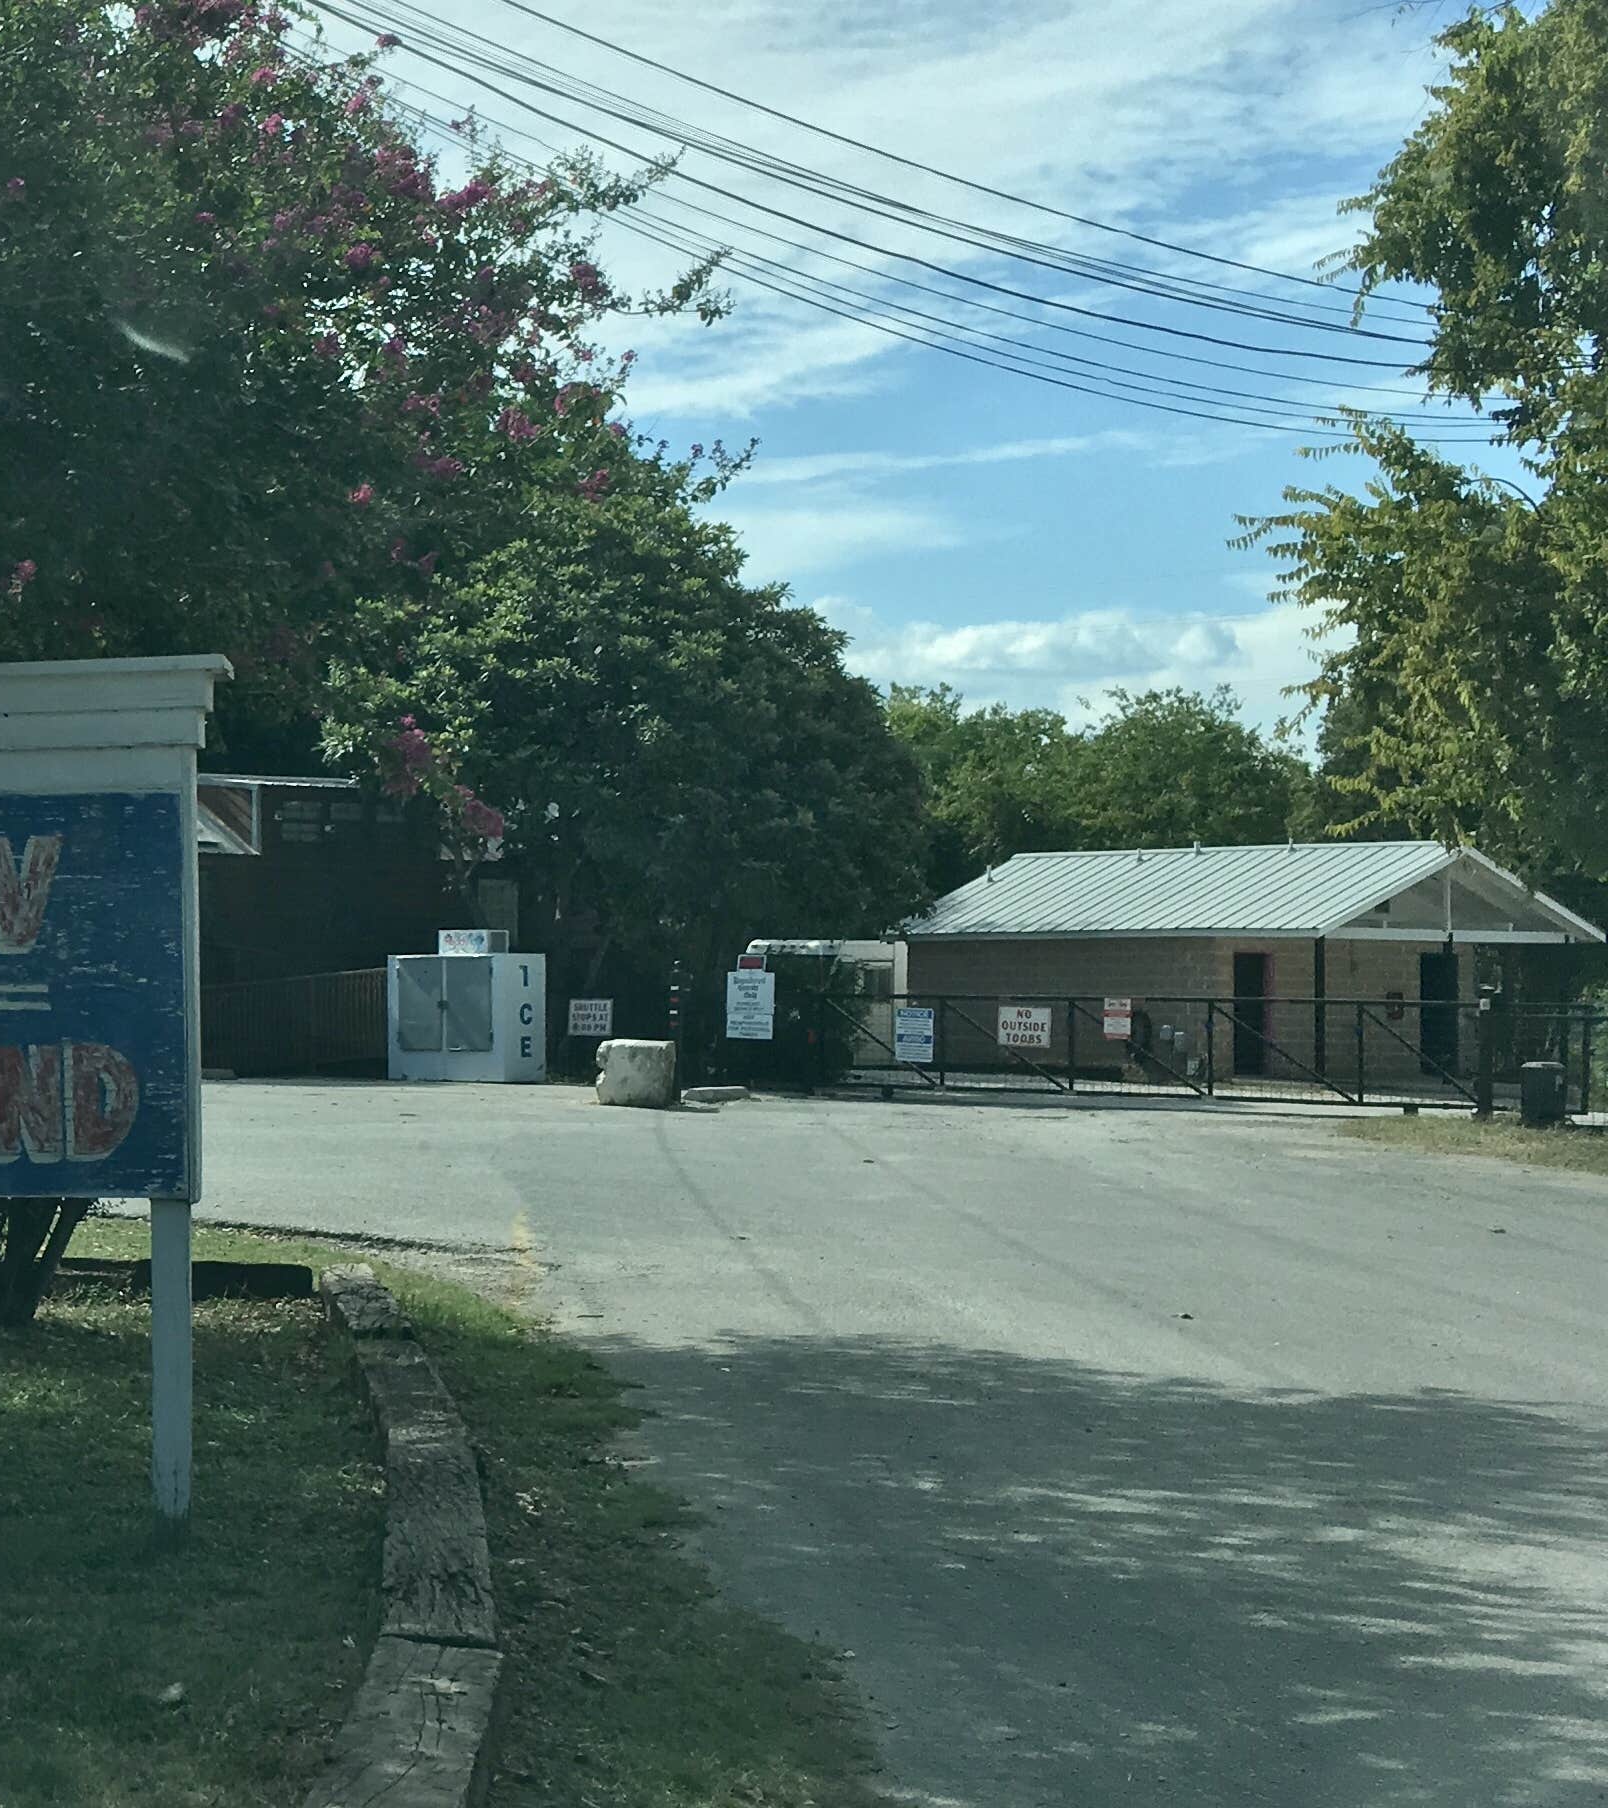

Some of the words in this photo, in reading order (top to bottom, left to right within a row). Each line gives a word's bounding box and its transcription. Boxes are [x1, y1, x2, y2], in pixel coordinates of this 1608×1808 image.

[574, 1003, 608, 1012] SHUTTLE
[572, 1013, 597, 1022] STOPS
[598, 1013, 609, 1022] AT
[1016, 1009, 1032, 1019] NO
[593, 1023, 607, 1032] PM
[1001, 1020, 1047, 1032] OUTSIDE
